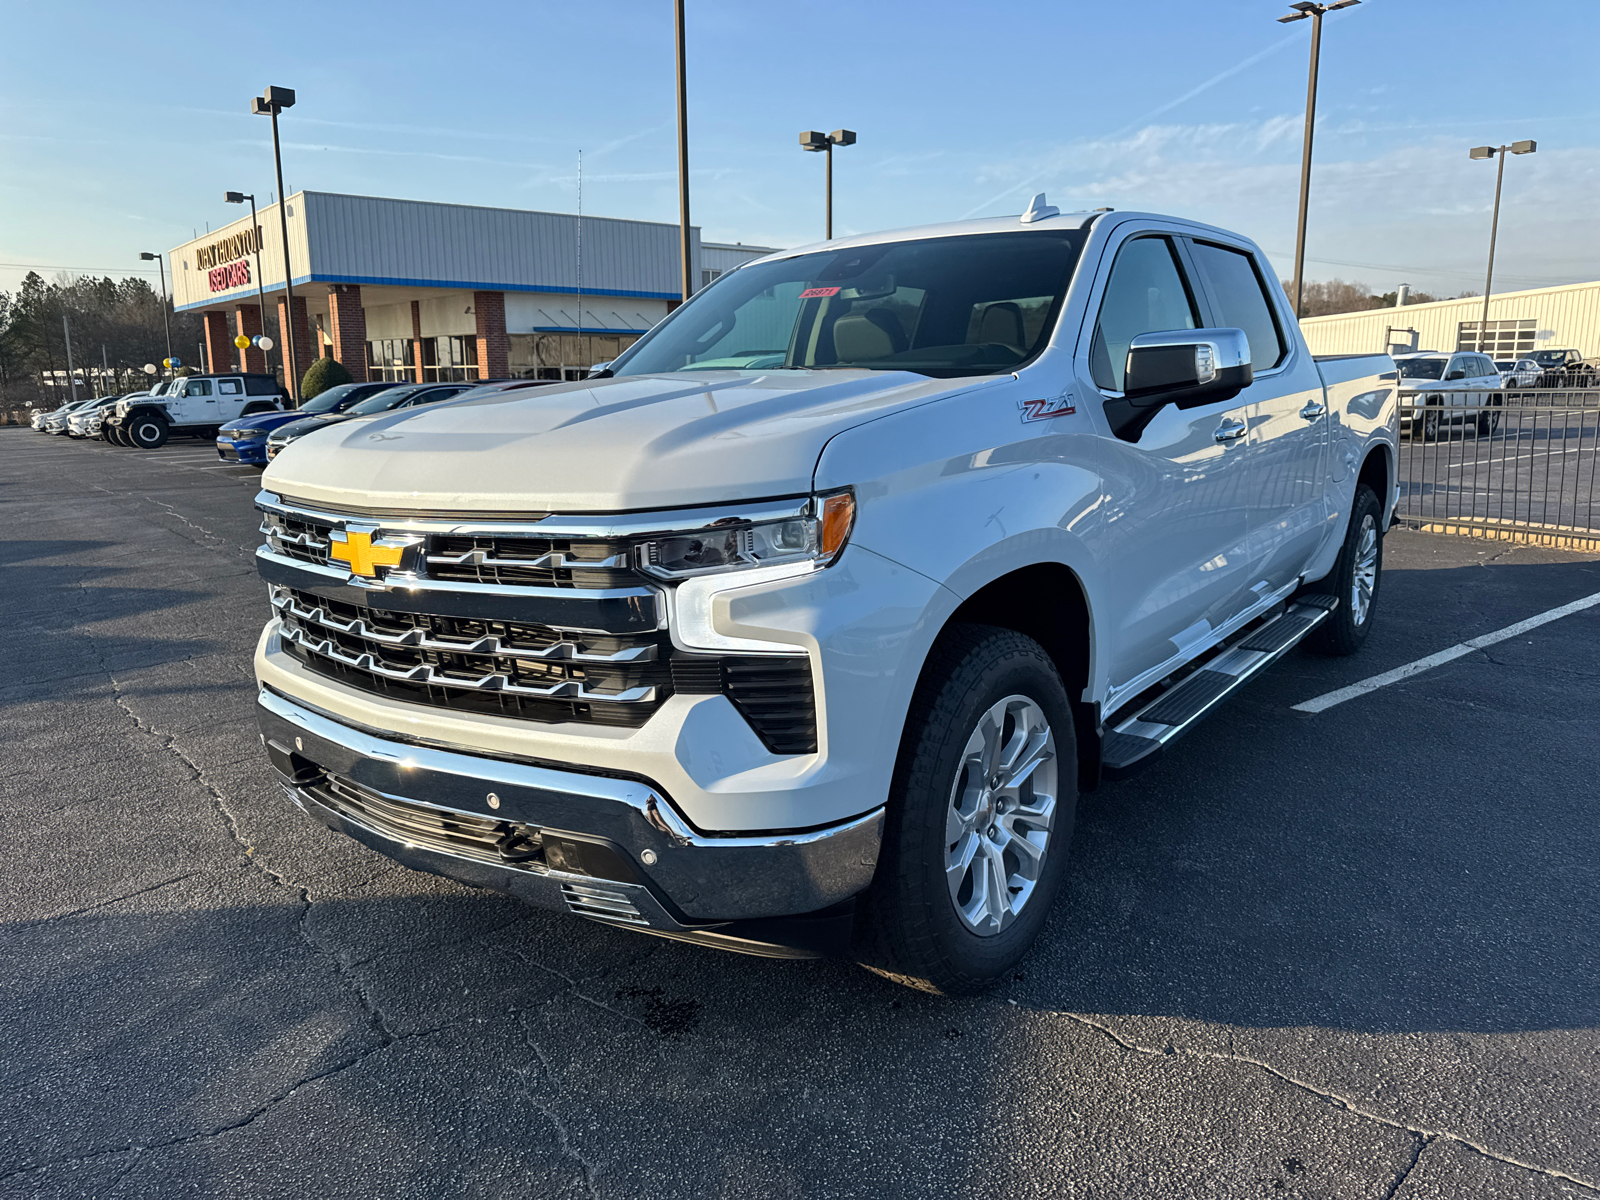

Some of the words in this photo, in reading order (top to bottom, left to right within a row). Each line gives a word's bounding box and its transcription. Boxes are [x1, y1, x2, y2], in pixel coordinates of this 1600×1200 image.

[208, 267, 228, 292] USED
[227, 259, 250, 288] CARS
[1016, 394, 1076, 424] Z71
